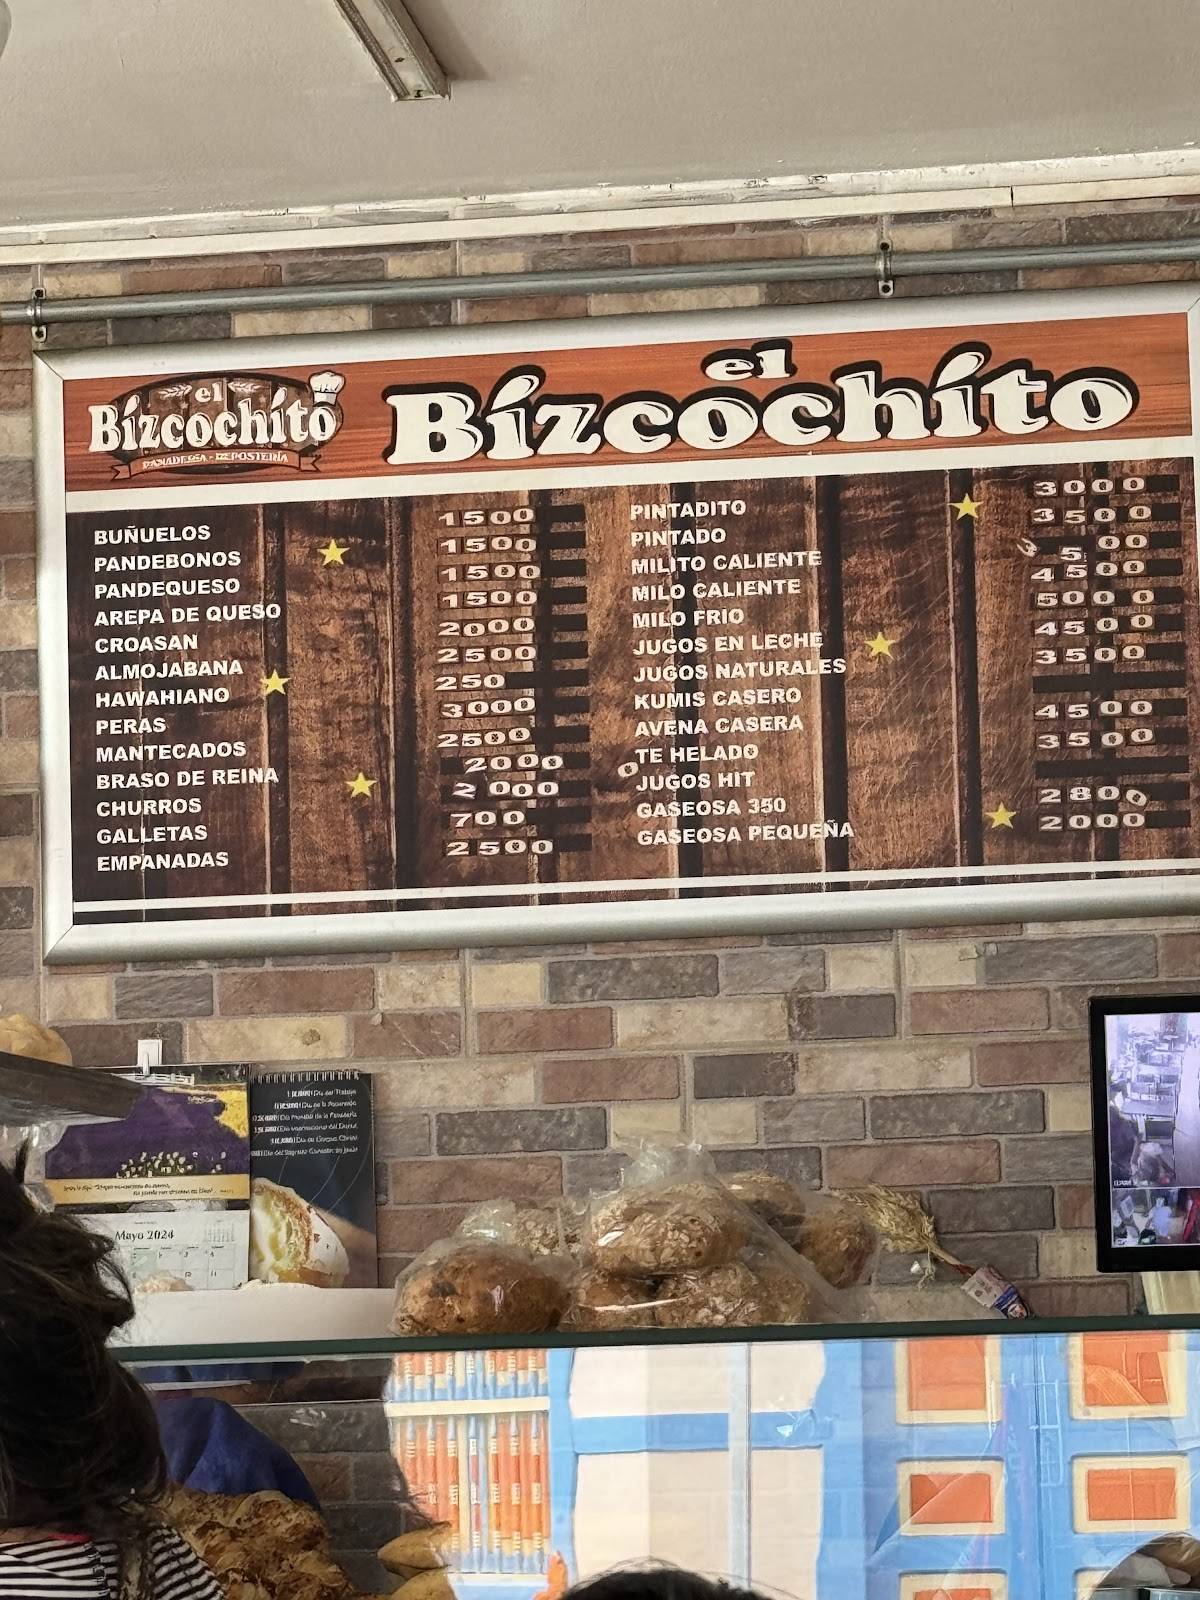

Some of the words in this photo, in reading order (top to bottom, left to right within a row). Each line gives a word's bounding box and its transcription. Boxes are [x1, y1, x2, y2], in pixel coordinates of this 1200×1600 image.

[702, 344, 795, 382] el
[195, 382, 224, 402] el
[1035, 477, 1144, 496] 3000
[438, 508, 534, 526] 1500
[630, 500, 747, 521] PINTADITO
[1033, 505, 1151, 524] 3500
[94, 525, 211, 545] BUÑUELOS
[440, 536, 537, 553] 1500
[630, 528, 726, 547] PINTADO
[94, 551, 241, 572] PANDEBONOS
[631, 555, 706, 574] MILITO
[713, 551, 822, 570] CALIENTE
[1031, 560, 1144, 582] 4500
[441, 564, 541, 582] 1500
[94, 578, 240, 599] PANDEQUESO
[632, 584, 686, 602] MILO
[692, 578, 801, 598] CALIENTE
[1037, 589, 1154, 607] 5000
[442, 590, 537, 609] 1500
[94, 609, 164, 626] AREPA
[171, 607, 200, 623] DE
[206, 603, 281, 622] QUESO
[632, 611, 686, 628] MILO
[438, 617, 535, 637] 2000
[1034, 614, 1153, 636] 4500
[95, 633, 198, 653] CROASAN
[632, 637, 708, 656] JUGOS
[714, 636, 744, 652] EN
[751, 632, 824, 650] LECHE
[437, 646, 537, 663] 2500
[1035, 645, 1144, 664] 3500
[95, 659, 244, 681] ALMOJABANA
[633, 664, 708, 683] JUGOS
[715, 658, 847, 680] NATURALES
[435, 674, 505, 690] 250
[95, 687, 230, 708] HAWAHIANO
[441, 697, 535, 718] 3000
[634, 691, 706, 709] KUMIS
[712, 687, 802, 707] CASERO
[1034, 700, 1153, 719] 4500
[96, 717, 167, 735] PERAS
[635, 719, 709, 737] AVENA
[715, 715, 804, 734] CASERA
[437, 727, 530, 748] 2500
[1038, 728, 1153, 749] 3500
[96, 741, 247, 762] MANTECADOS
[635, 748, 663, 764] TE
[670, 744, 759, 763] HELADO
[464, 754, 563, 773] 2000
[96, 772, 170, 790] BRASO
[177, 770, 206, 787] DE
[212, 767, 279, 785] REINA
[636, 773, 711, 791] JUGOS
[718, 771, 755, 788] HIT
[1039, 785, 1147, 807] 2800
[96, 798, 202, 817] CHURROS
[637, 800, 741, 818] GASEOSA
[749, 797, 787, 814] 350
[451, 810, 525, 828] 700
[1040, 812, 1145, 831] 2000
[96, 824, 208, 844] GALLETAS
[637, 827, 742, 846] GASEOSA
[749, 819, 855, 841] PEQUEÑA
[446, 839, 553, 856] 2500
[97, 851, 229, 872] EMPANADAS
[115, 1230, 144, 1242] Mayo
[147, 1229, 174, 1240] 2024
